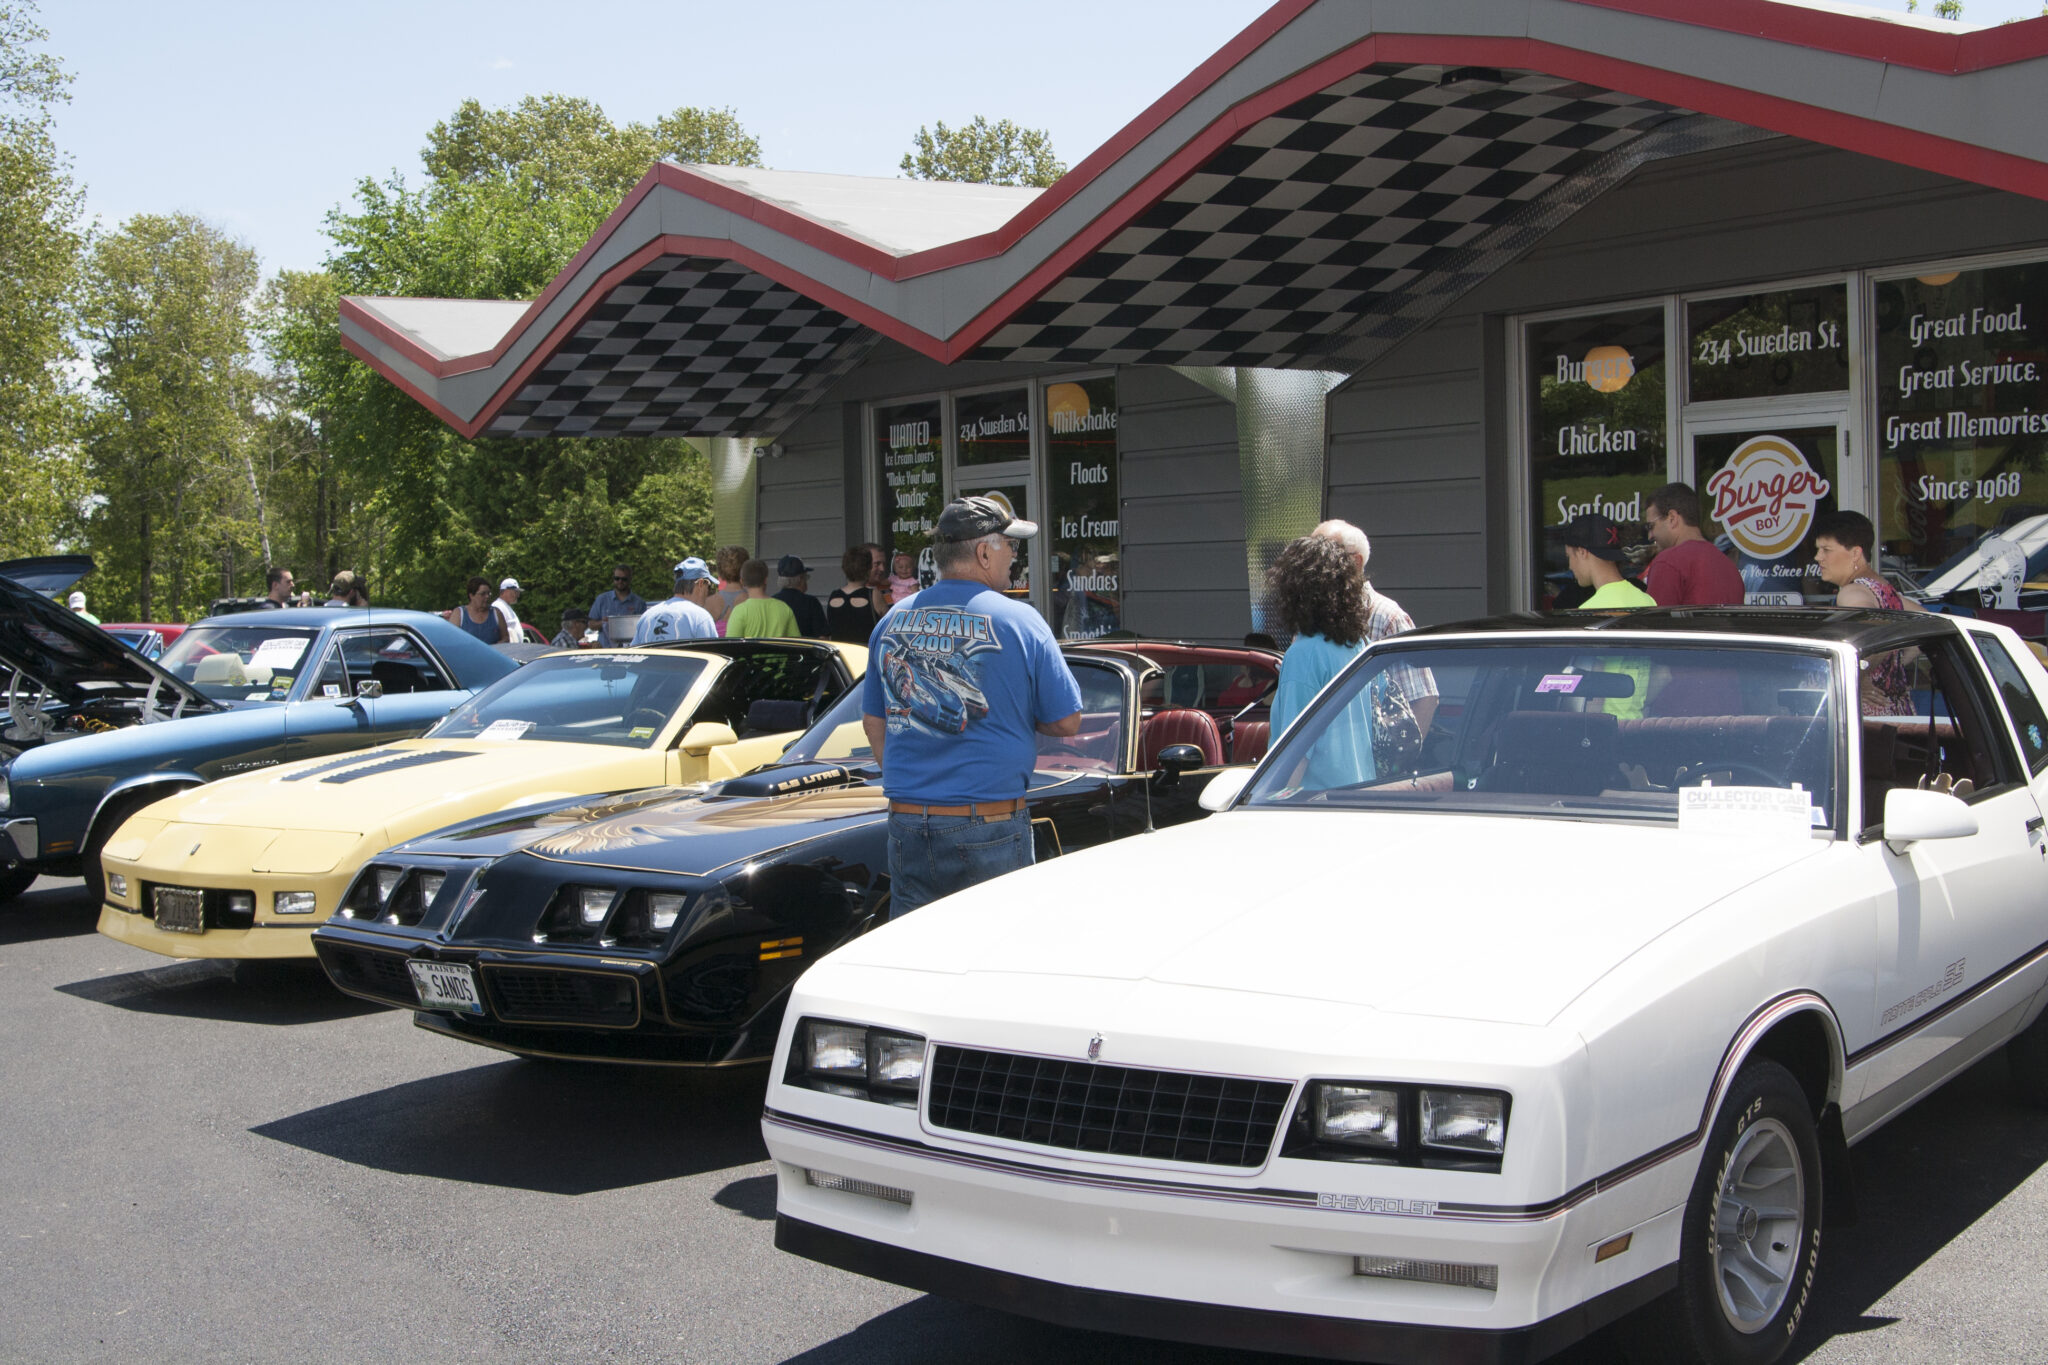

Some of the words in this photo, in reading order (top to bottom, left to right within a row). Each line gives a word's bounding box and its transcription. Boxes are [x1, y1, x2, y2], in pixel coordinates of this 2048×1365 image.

[1910, 312, 1966, 348] Great
[1971, 303, 2027, 336] Food.
[1699, 339, 1731, 365] 234
[1737, 325, 1812, 357] Sweden
[1818, 321, 1840, 349] St.
[1557, 354, 1636, 390] Burgers
[1900, 363, 1955, 399] Great
[1960, 356, 2041, 388] Service.
[889, 421, 930, 449] WANTED
[960, 423, 977, 442] 234
[978, 414, 1016, 437] Sweden
[1557, 423, 1637, 456] Chicken
[1886, 415, 1942, 449] Great
[1947, 407, 2048, 439] Memories
[885, 451, 894, 467] Ice
[894, 450, 914, 466] Cream
[914, 449, 935, 464] Lovers
[906, 470, 921, 486] Your
[921, 469, 936, 484] Own
[1070, 461, 1109, 485] Floats
[1709, 470, 1826, 518] Burger
[1918, 475, 1970, 501] Since
[1975, 471, 2021, 504] 1968
[892, 520, 899, 533] at
[899, 517, 920, 536] Burger
[1061, 516, 1078, 539] Ice
[1081, 515, 1119, 538] Cream
[1756, 515, 1780, 531] BOY
[1066, 568, 1118, 592] Sundaes
[1750, 565, 1769, 578] You
[1771, 564, 1802, 577] Since
[1750, 595, 1788, 606] HOURS
[888, 609, 990, 642] ALLSTATE
[910, 633, 954, 654] 400
[1686, 790, 1772, 804] COLLECTOR
[1776, 792, 1806, 806] CAR
[426, 964, 455, 974] MAINE
[431, 974, 474, 1001] SANDS
[1317, 1192, 1437, 1216] CHEVROLET
[1786, 1228, 1820, 1336] COOPER
